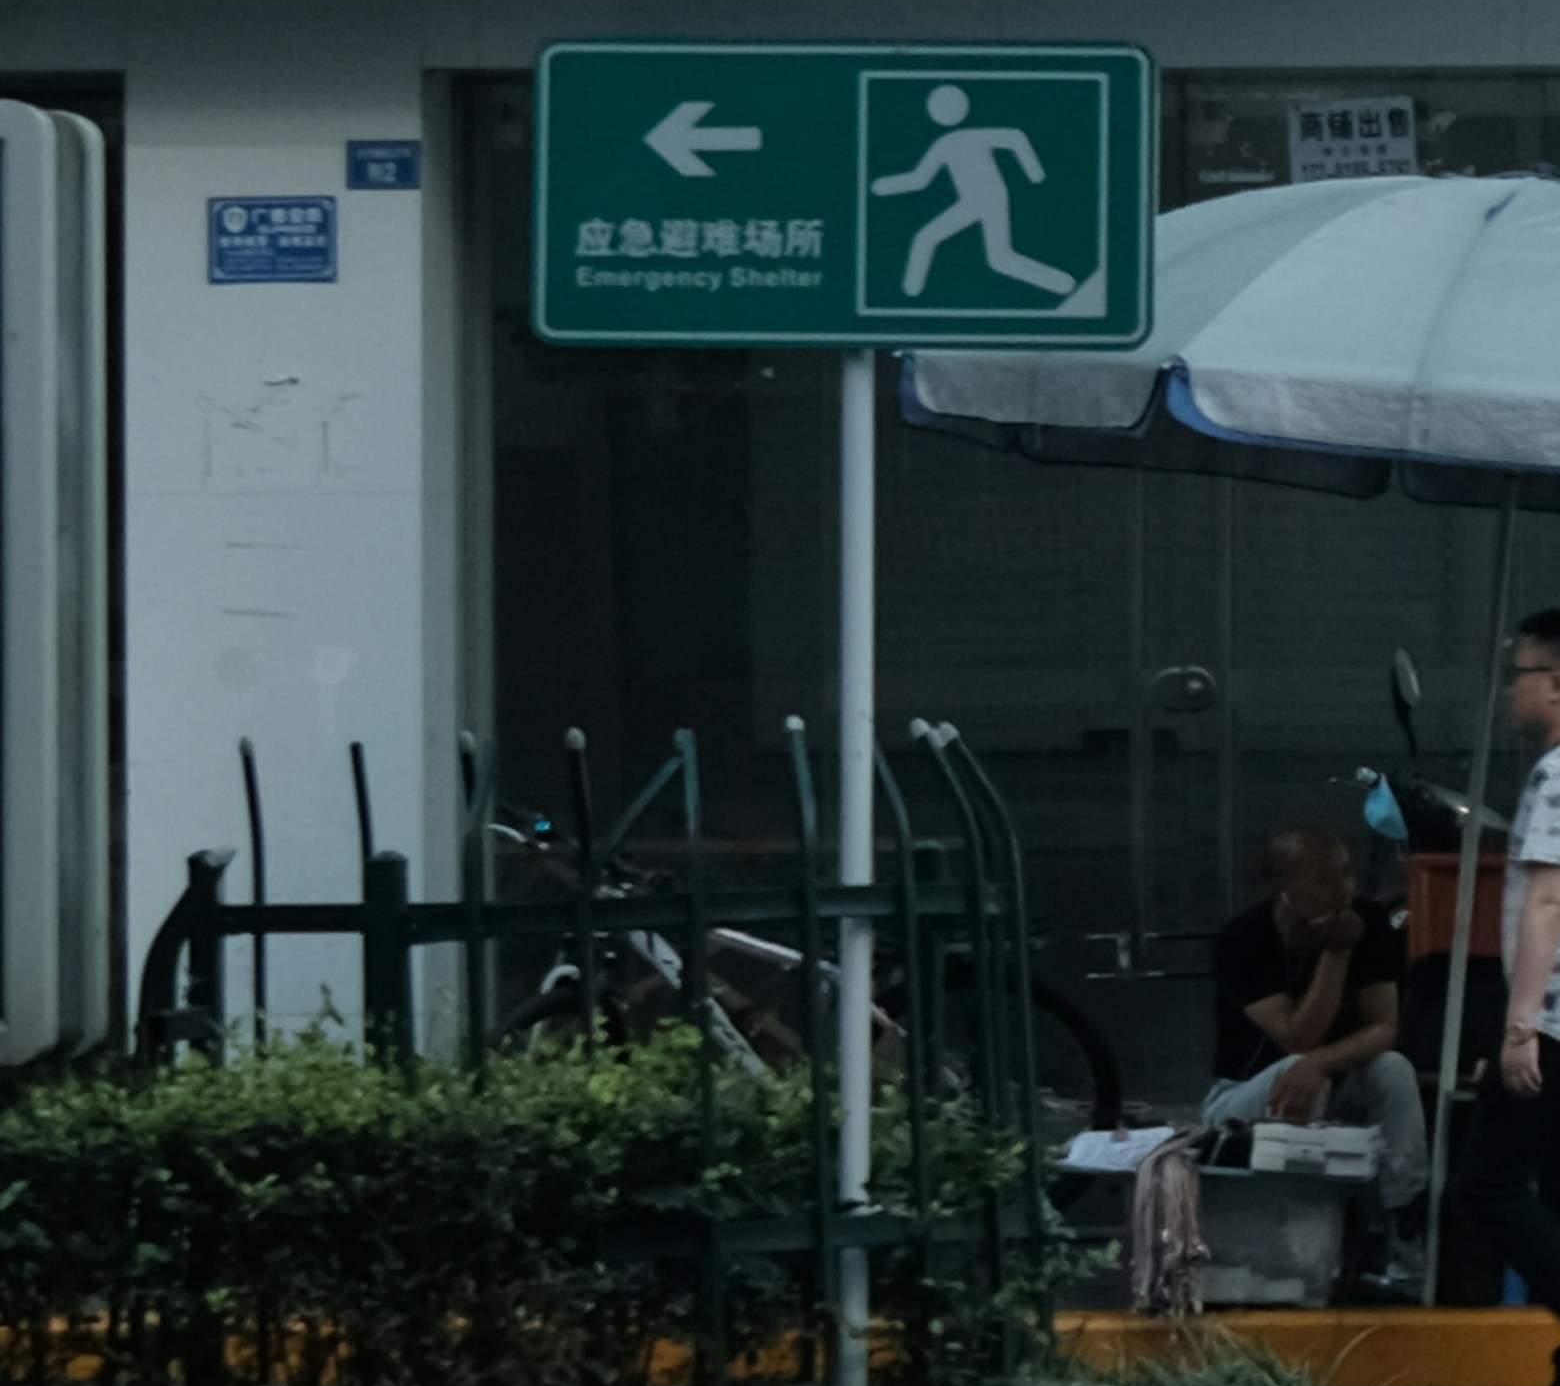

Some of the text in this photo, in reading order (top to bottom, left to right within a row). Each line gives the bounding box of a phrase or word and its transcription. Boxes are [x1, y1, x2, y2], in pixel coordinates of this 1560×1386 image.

[575, 218, 824, 258] 应急避难场所
[575, 266, 823, 291] Emergency Shelter
